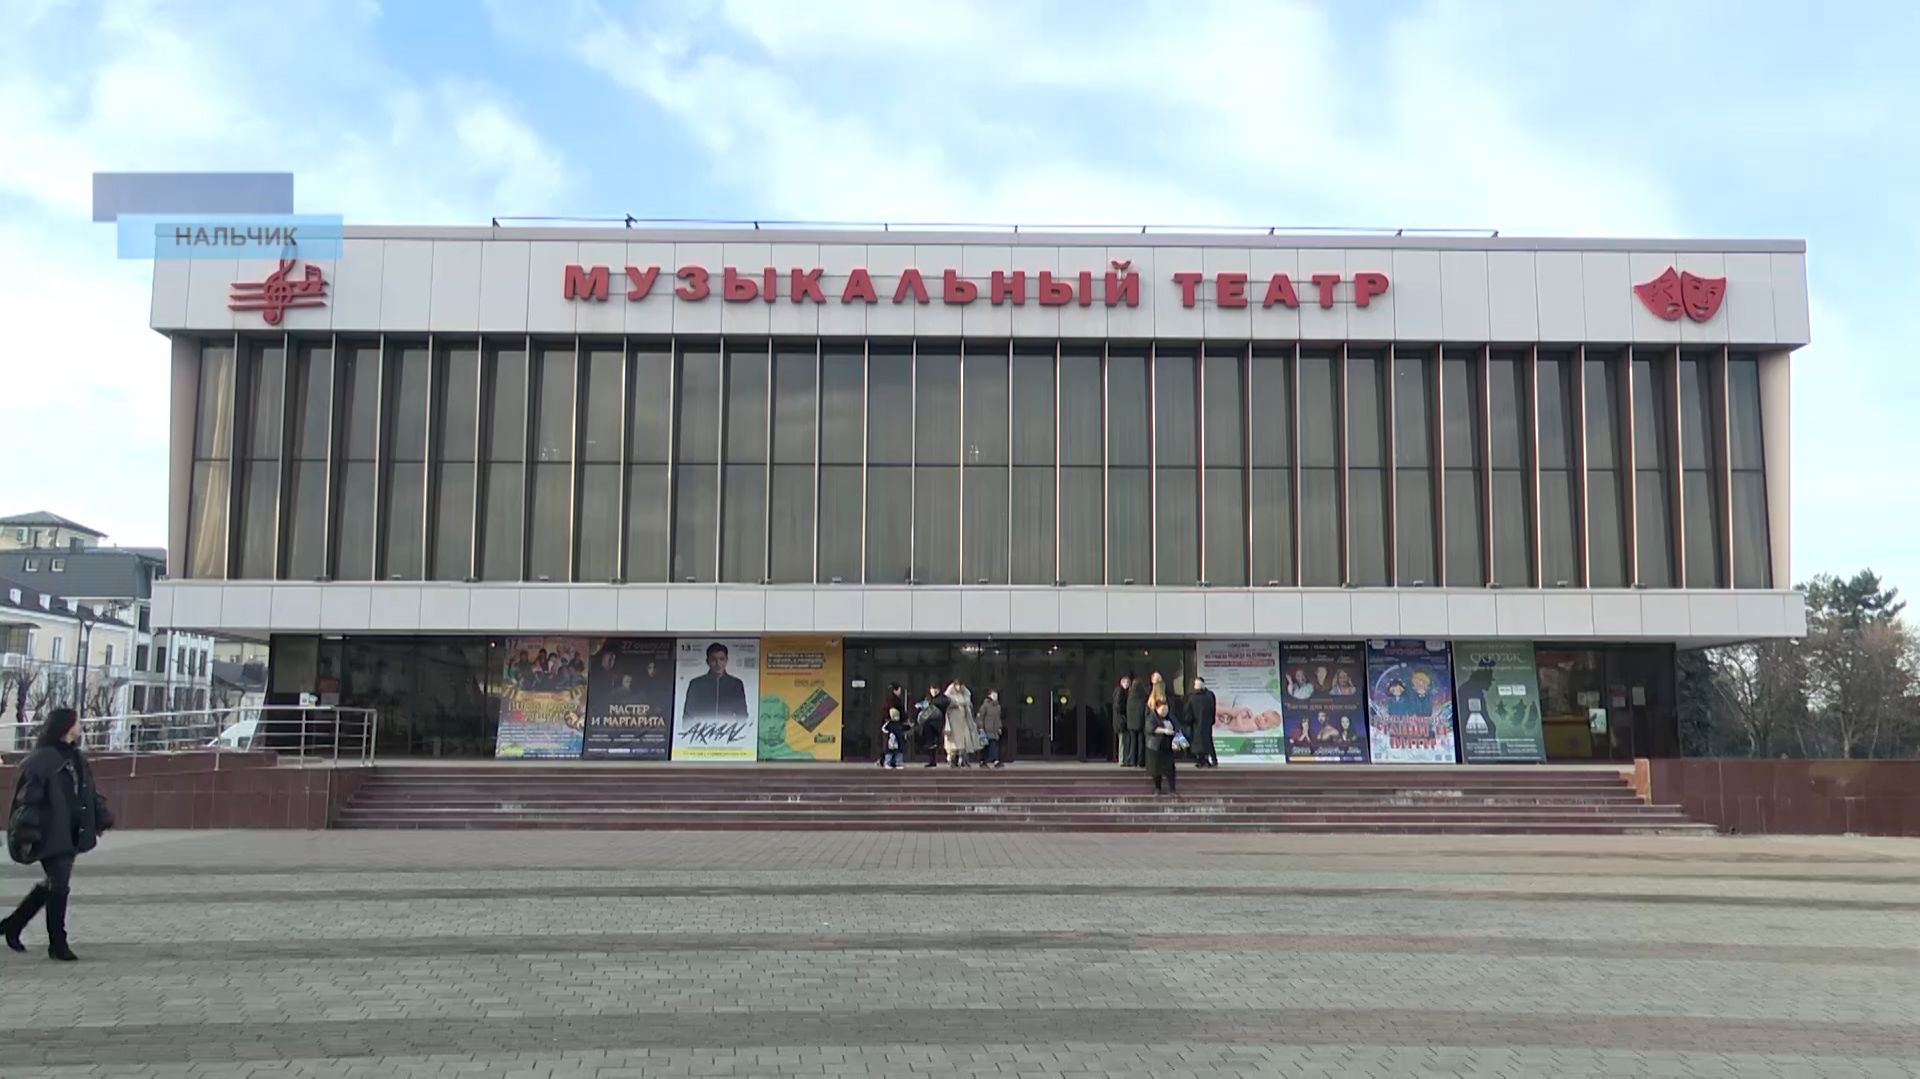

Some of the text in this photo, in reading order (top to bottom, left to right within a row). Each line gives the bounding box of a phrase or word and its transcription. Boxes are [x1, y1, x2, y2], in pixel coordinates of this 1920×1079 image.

[564, 260, 1390, 309] МУЗЫКАЛЬНЫЙ ТЕАТР
[609, 703, 651, 716] МАСТЕР
[591, 715, 666, 728] И МАРГАРИТА
